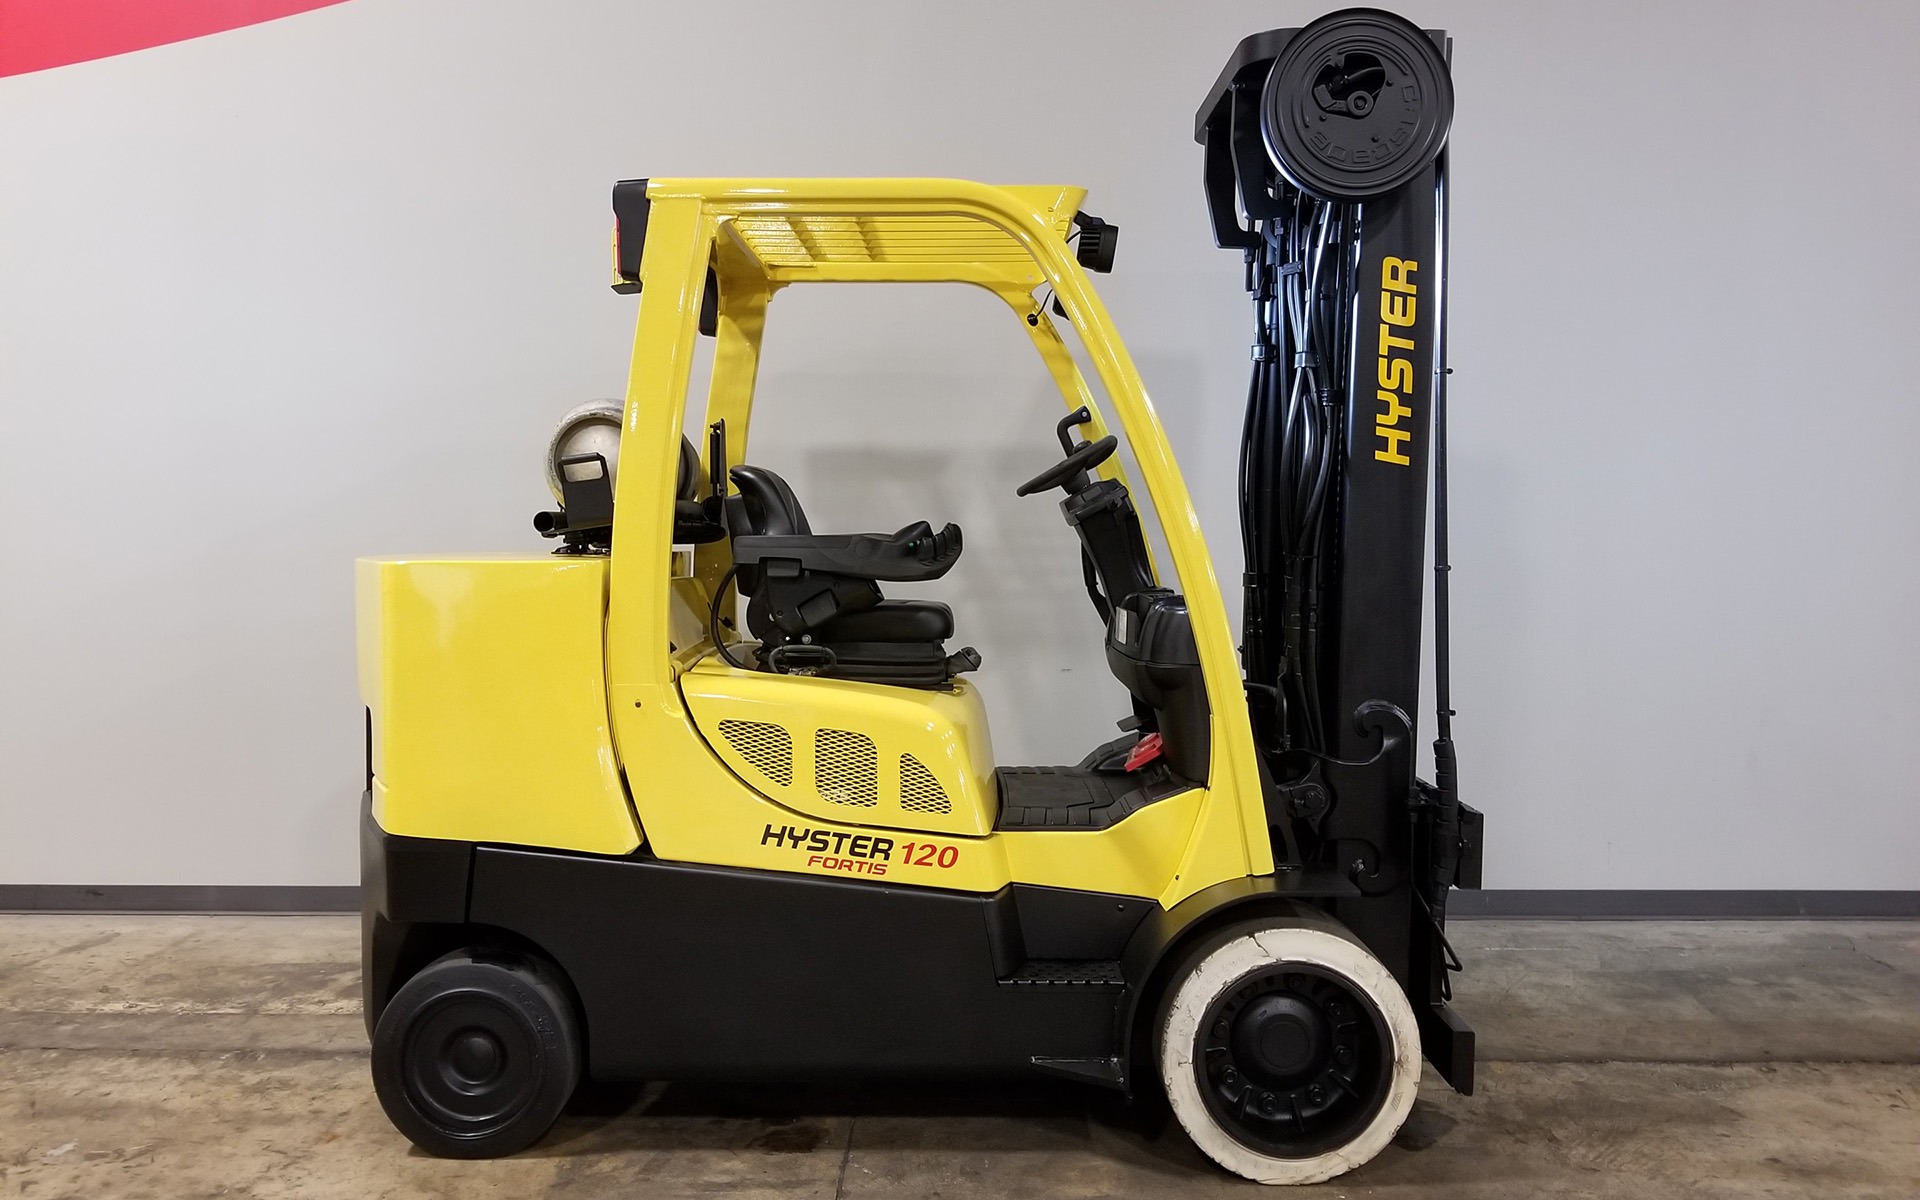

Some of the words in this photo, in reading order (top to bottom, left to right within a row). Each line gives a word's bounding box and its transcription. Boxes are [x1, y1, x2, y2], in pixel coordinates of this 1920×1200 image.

[1374, 256, 1418, 466] HYSTER
[761, 824, 894, 861] HYSTER
[901, 842, 960, 869] 120
[807, 856, 888, 876] FORTIS
